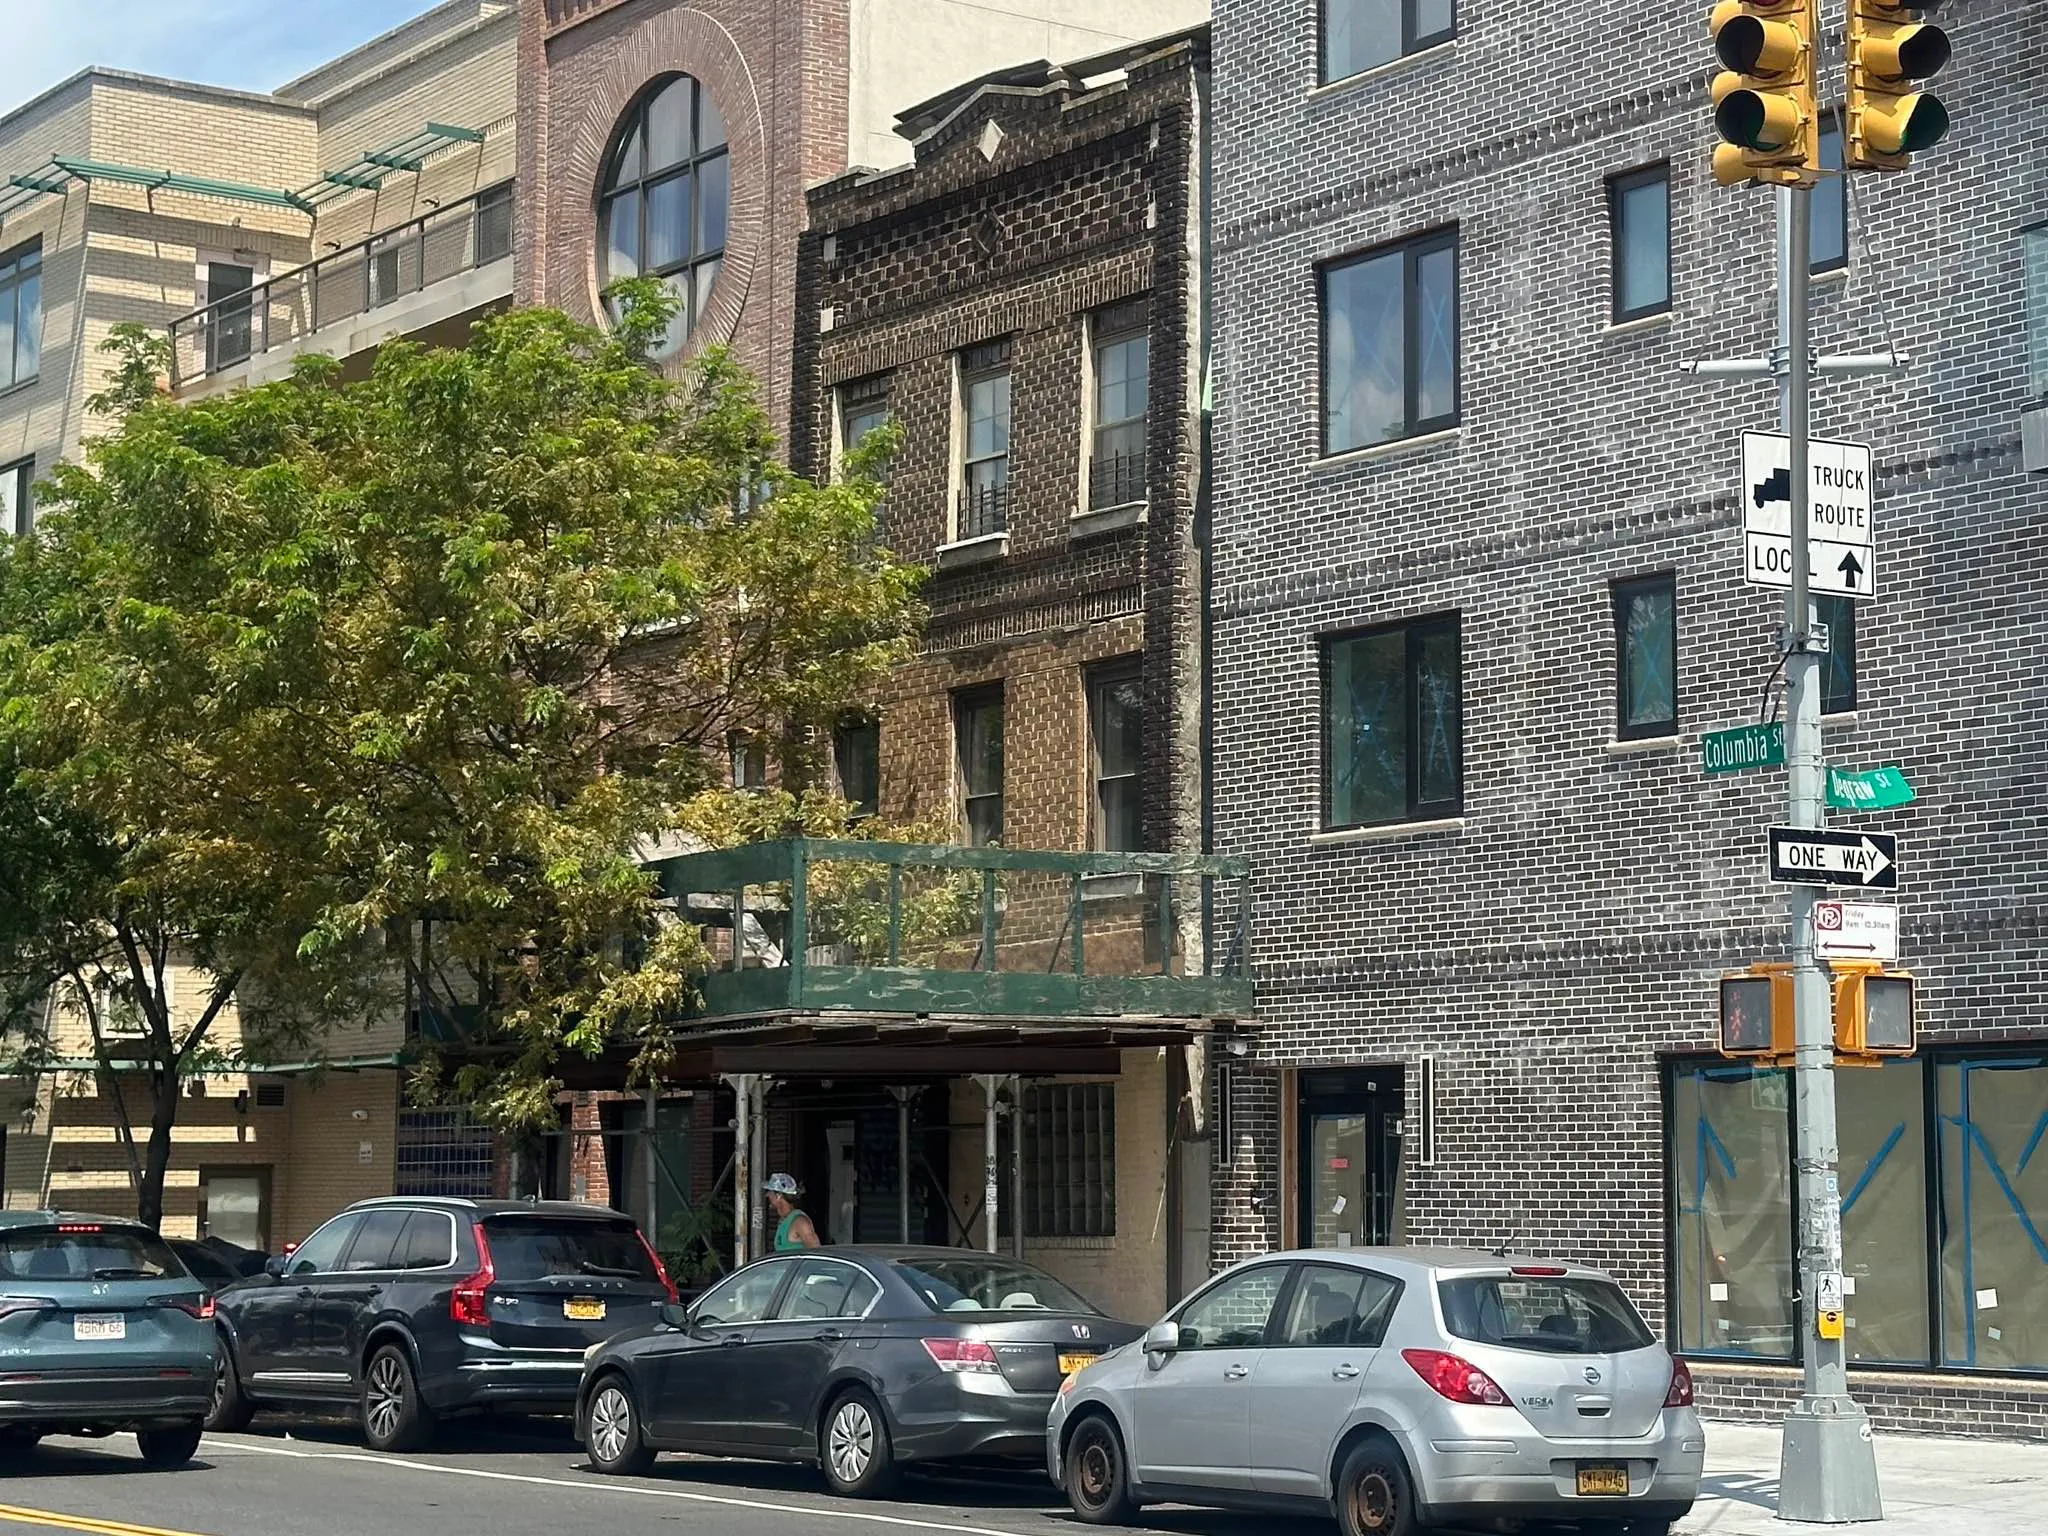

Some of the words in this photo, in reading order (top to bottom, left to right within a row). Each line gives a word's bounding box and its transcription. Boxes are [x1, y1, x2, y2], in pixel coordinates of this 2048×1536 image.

[1813, 465, 1865, 490] TRUCK
[1815, 503, 1865, 527] ROUTE
[1754, 545, 1817, 577] LOCL
[1705, 729, 1768, 768] Columbia
[1772, 727, 1783, 747] St
[1831, 770, 1876, 807] Degraw
[1874, 773, 1892, 788] St
[1789, 845, 1826, 868] ONE
[1842, 846, 1878, 871] WAY
[1845, 909, 1864, 919] Friday
[1521, 1397, 1554, 1405] VERSA
